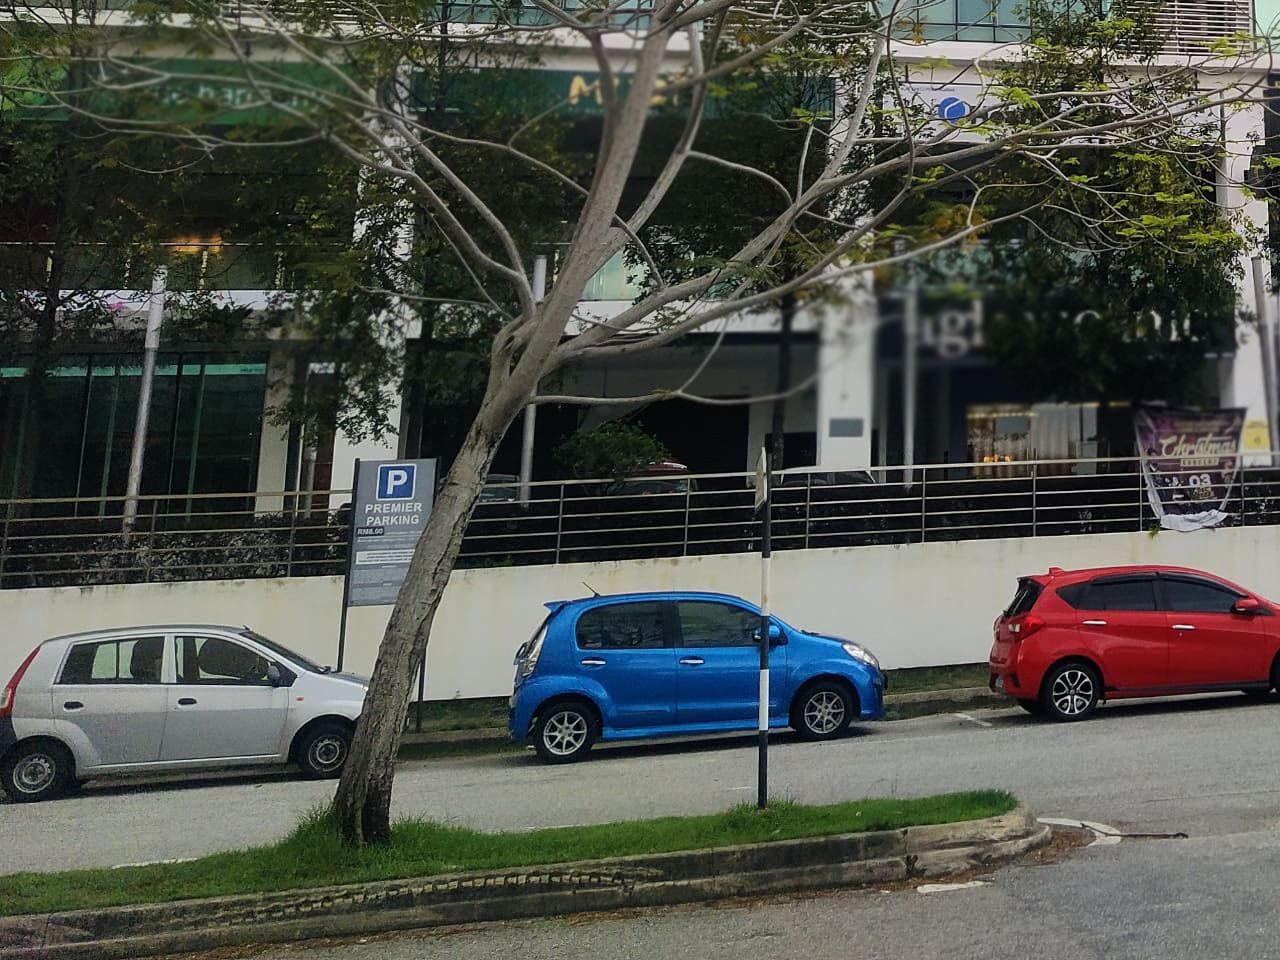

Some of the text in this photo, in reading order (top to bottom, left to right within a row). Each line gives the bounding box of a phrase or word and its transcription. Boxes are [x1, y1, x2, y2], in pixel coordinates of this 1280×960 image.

[386, 469, 408, 495] P
[364, 502, 423, 514] PREMIER
[366, 514, 420, 526] PARKING
